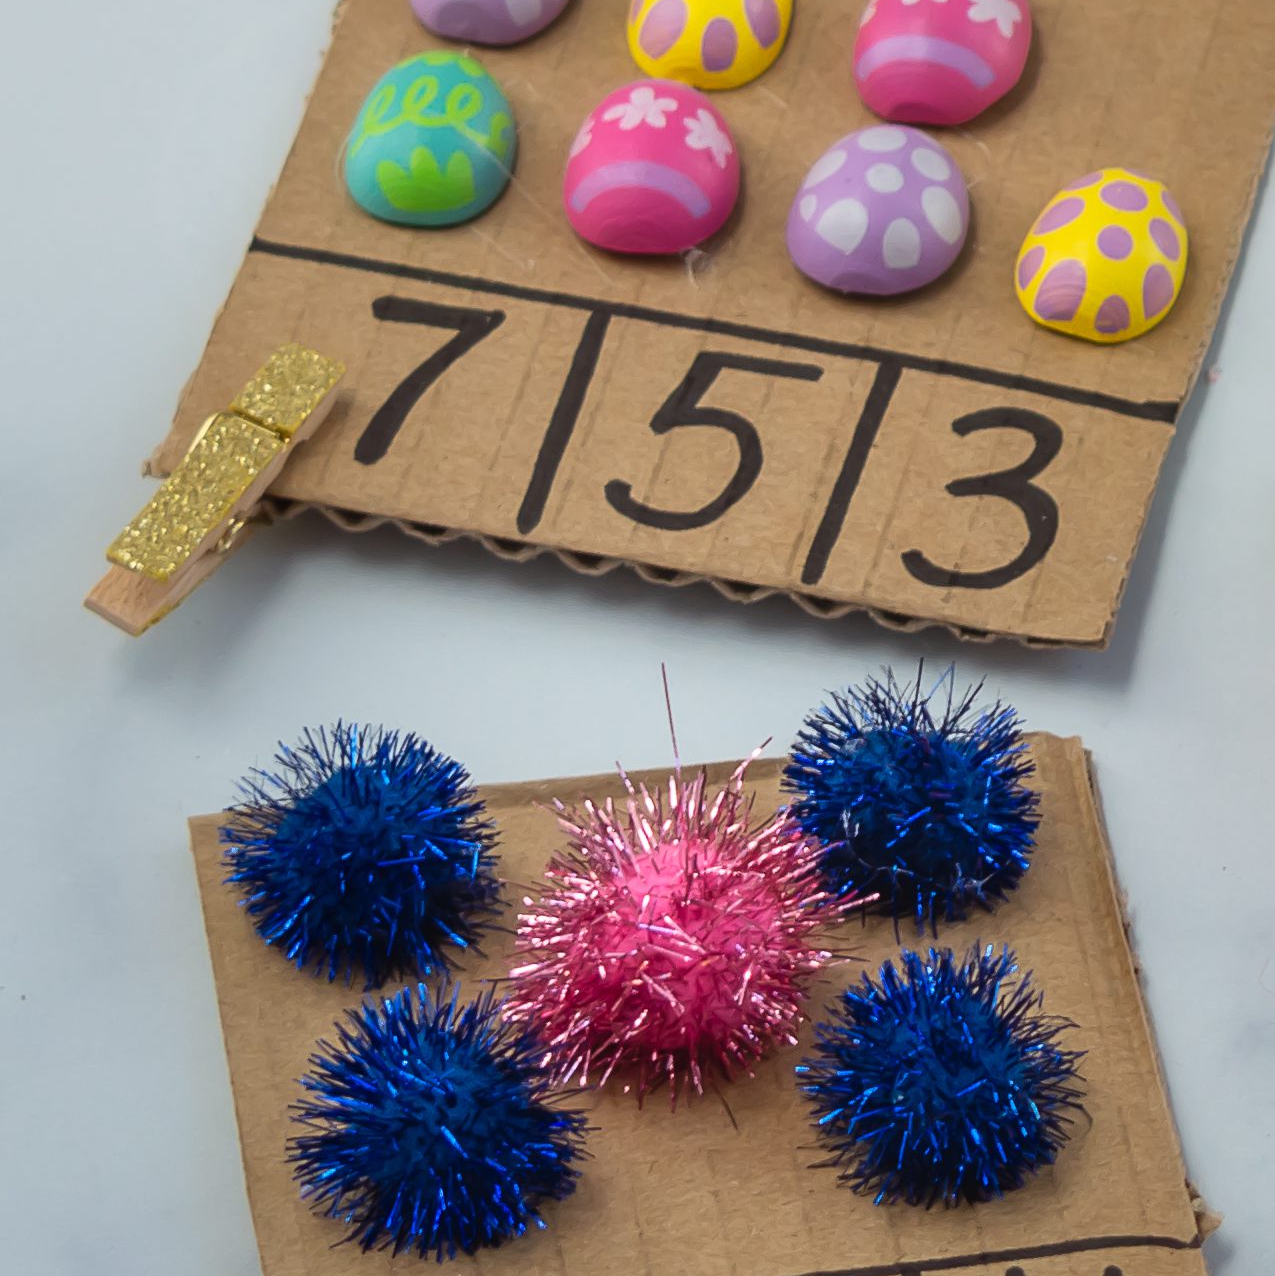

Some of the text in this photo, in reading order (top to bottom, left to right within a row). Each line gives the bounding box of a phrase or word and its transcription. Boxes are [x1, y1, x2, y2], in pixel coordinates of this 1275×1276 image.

[354, 296, 1065, 590] 7 5 3
